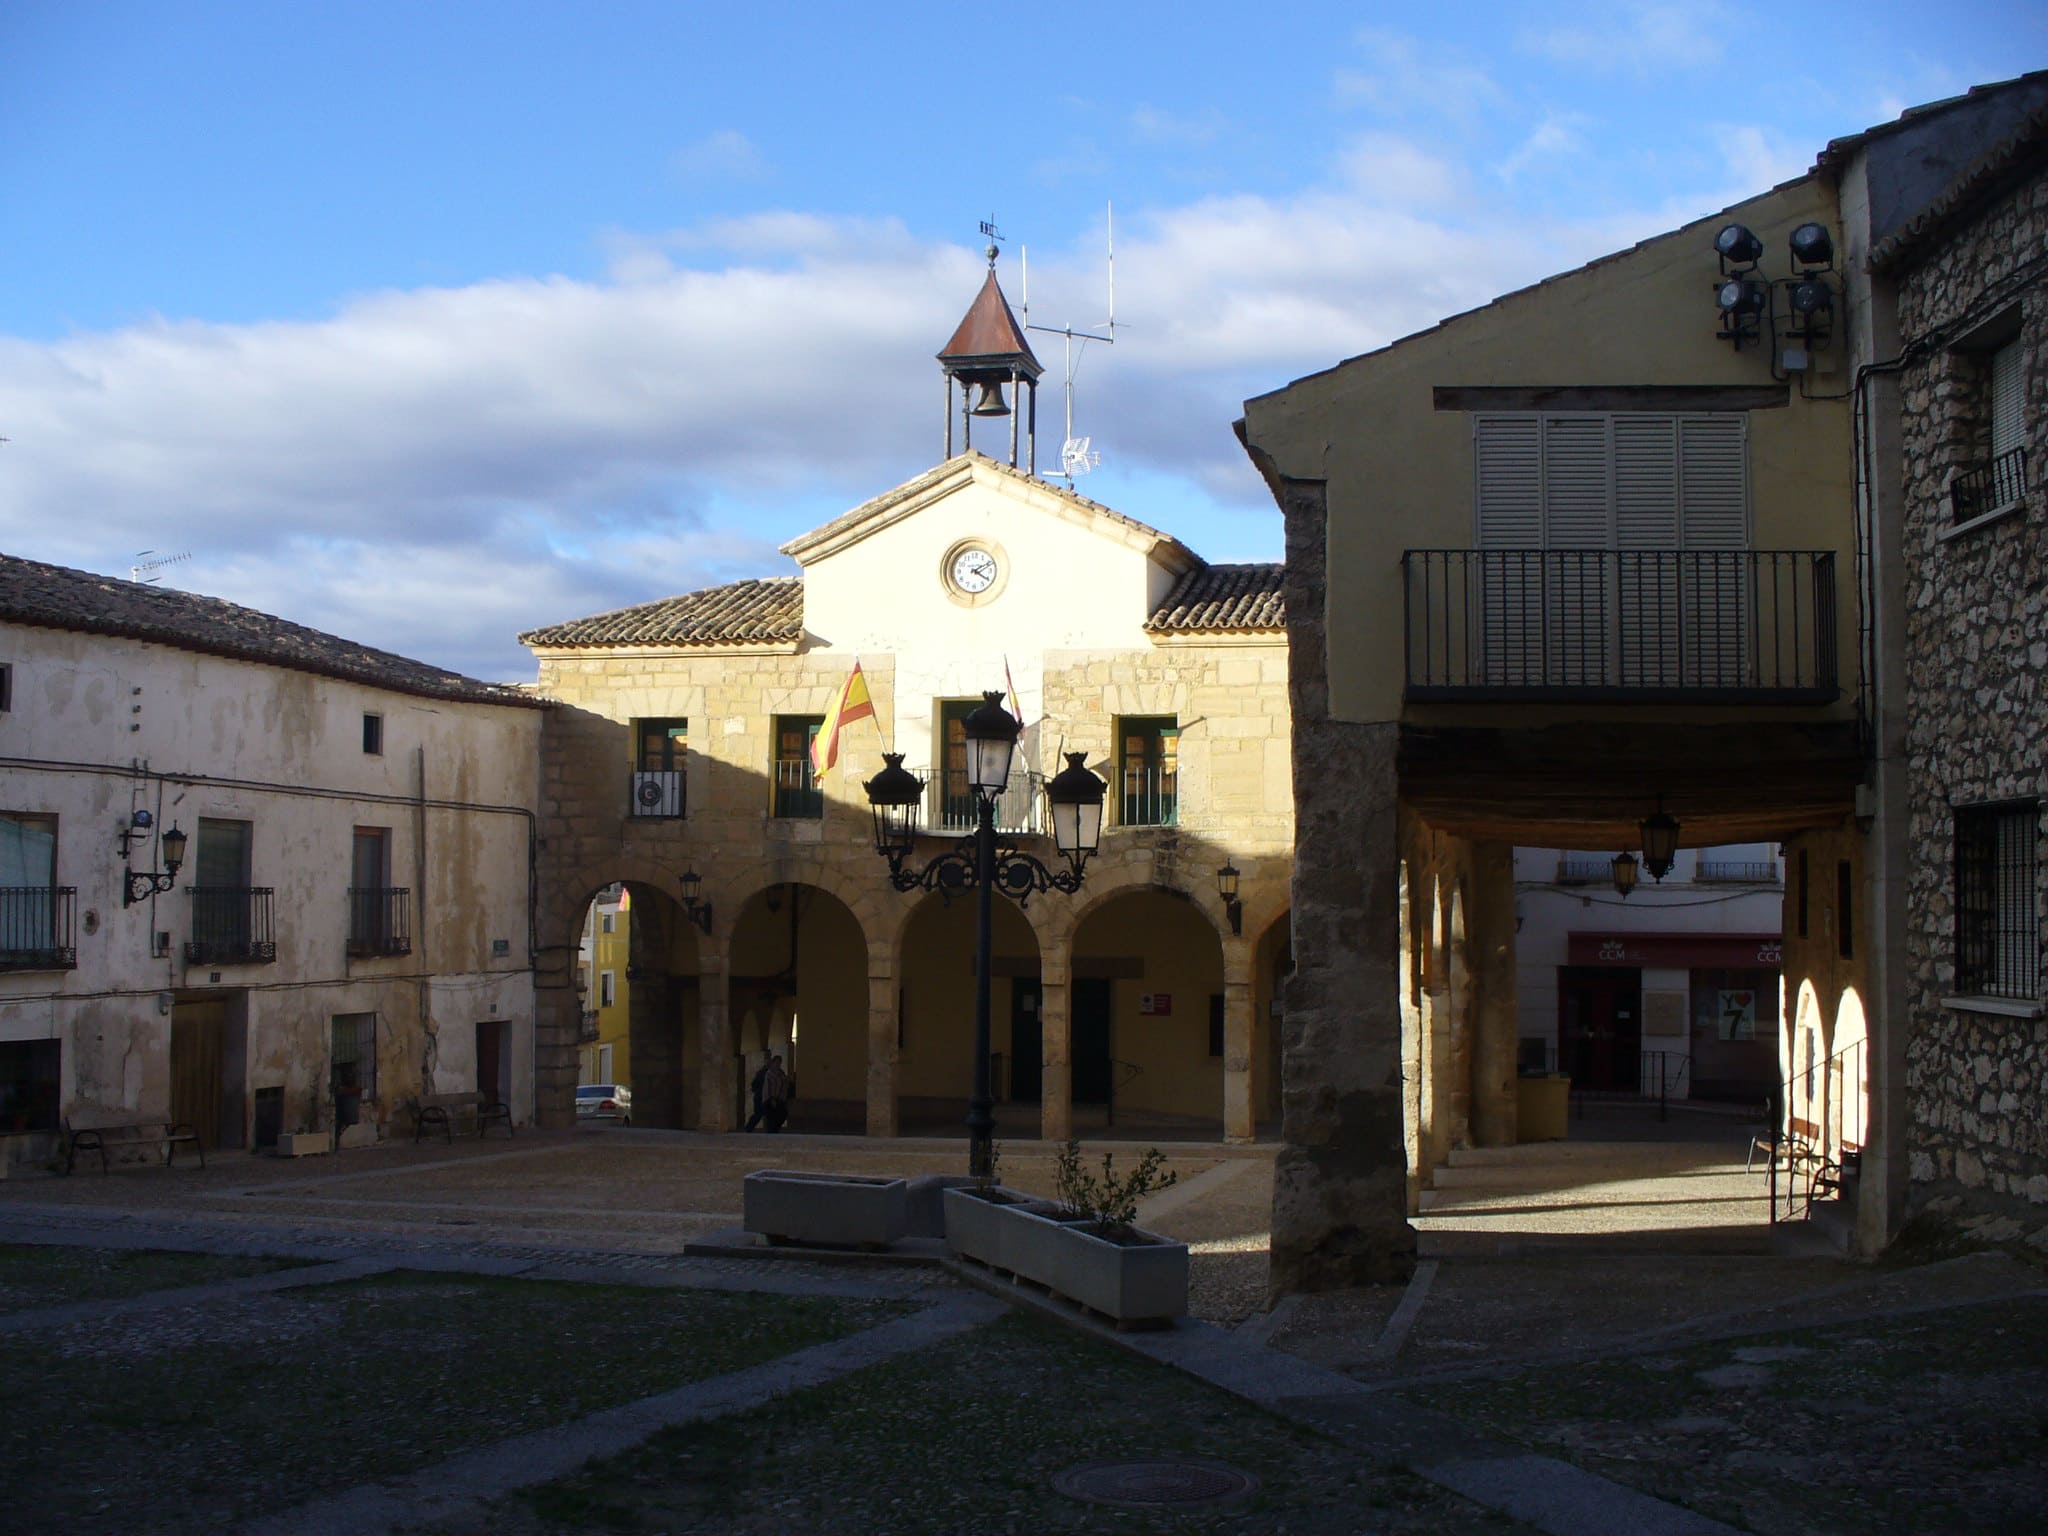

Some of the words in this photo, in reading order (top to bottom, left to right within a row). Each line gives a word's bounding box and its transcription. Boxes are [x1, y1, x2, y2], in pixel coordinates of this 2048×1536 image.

[1599, 950, 1625, 961] CCM
[1722, 993, 1734, 1009] Y
[1724, 1010, 1743, 1040] 7
